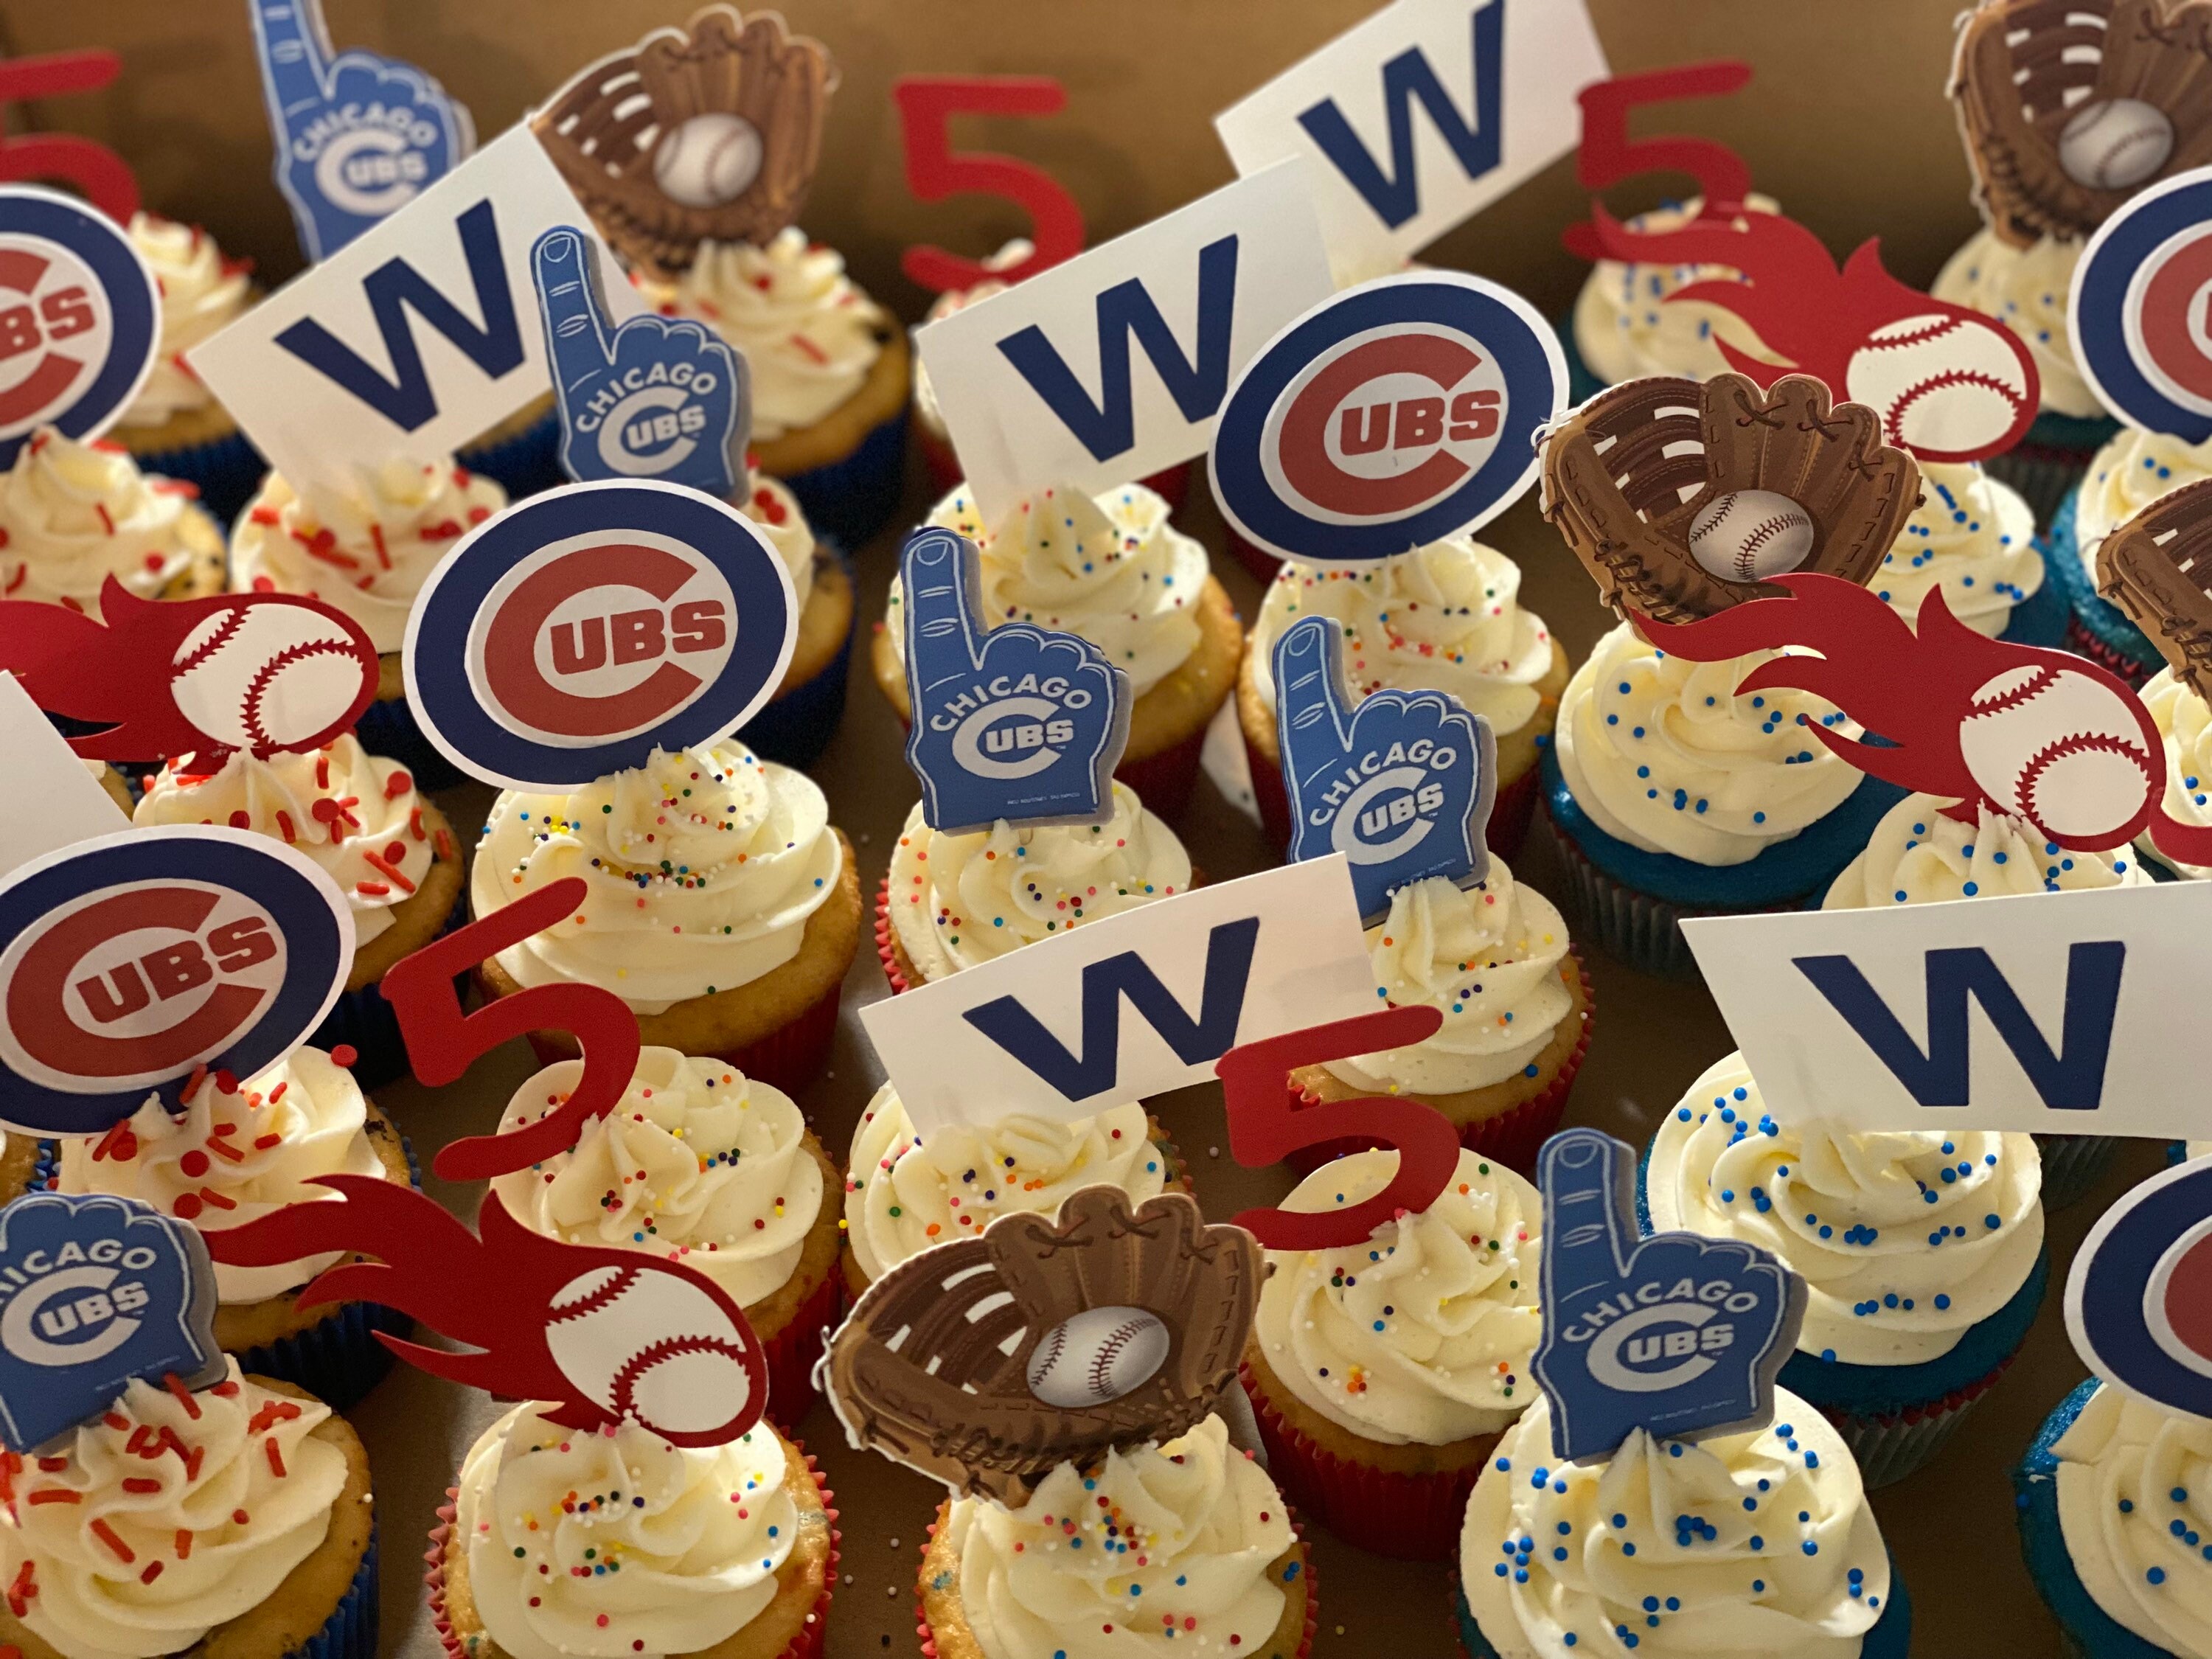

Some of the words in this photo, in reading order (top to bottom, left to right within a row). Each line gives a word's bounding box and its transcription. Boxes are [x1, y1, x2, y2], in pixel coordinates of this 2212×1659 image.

[293, 102, 438, 161] CHICAGO
[316, 128, 428, 216] CUBS
[1296, 0, 1506, 231] W
[1562, 60, 1755, 264] 5
[892, 76, 1085, 295] 5
[272, 198, 526, 434] W
[995, 234, 1239, 463] W
[576, 362, 717, 432] CHICAGO
[598, 386, 706, 476] CUBS
[1279, 333, 1501, 515] CUBS
[484, 543, 726, 736] CUBS
[930, 673, 1092, 731] CHICAGO
[952, 697, 1074, 779] CUBS
[1310, 739, 1456, 826] CHICAGO
[1331, 767, 1444, 865] CUBS
[7, 887, 277, 1077] CUBS
[380, 877, 641, 1181] 5
[961, 917, 1259, 1102] W
[1791, 941, 2125, 1110] W
[1215, 1004, 1460, 1251] 5
[0, 1239, 157, 1300] ICAGO
[1, 1266, 149, 1366] CUBS
[1561, 1278, 1758, 1342] CHICAGO
[1586, 1302, 1734, 1392] CUBS
